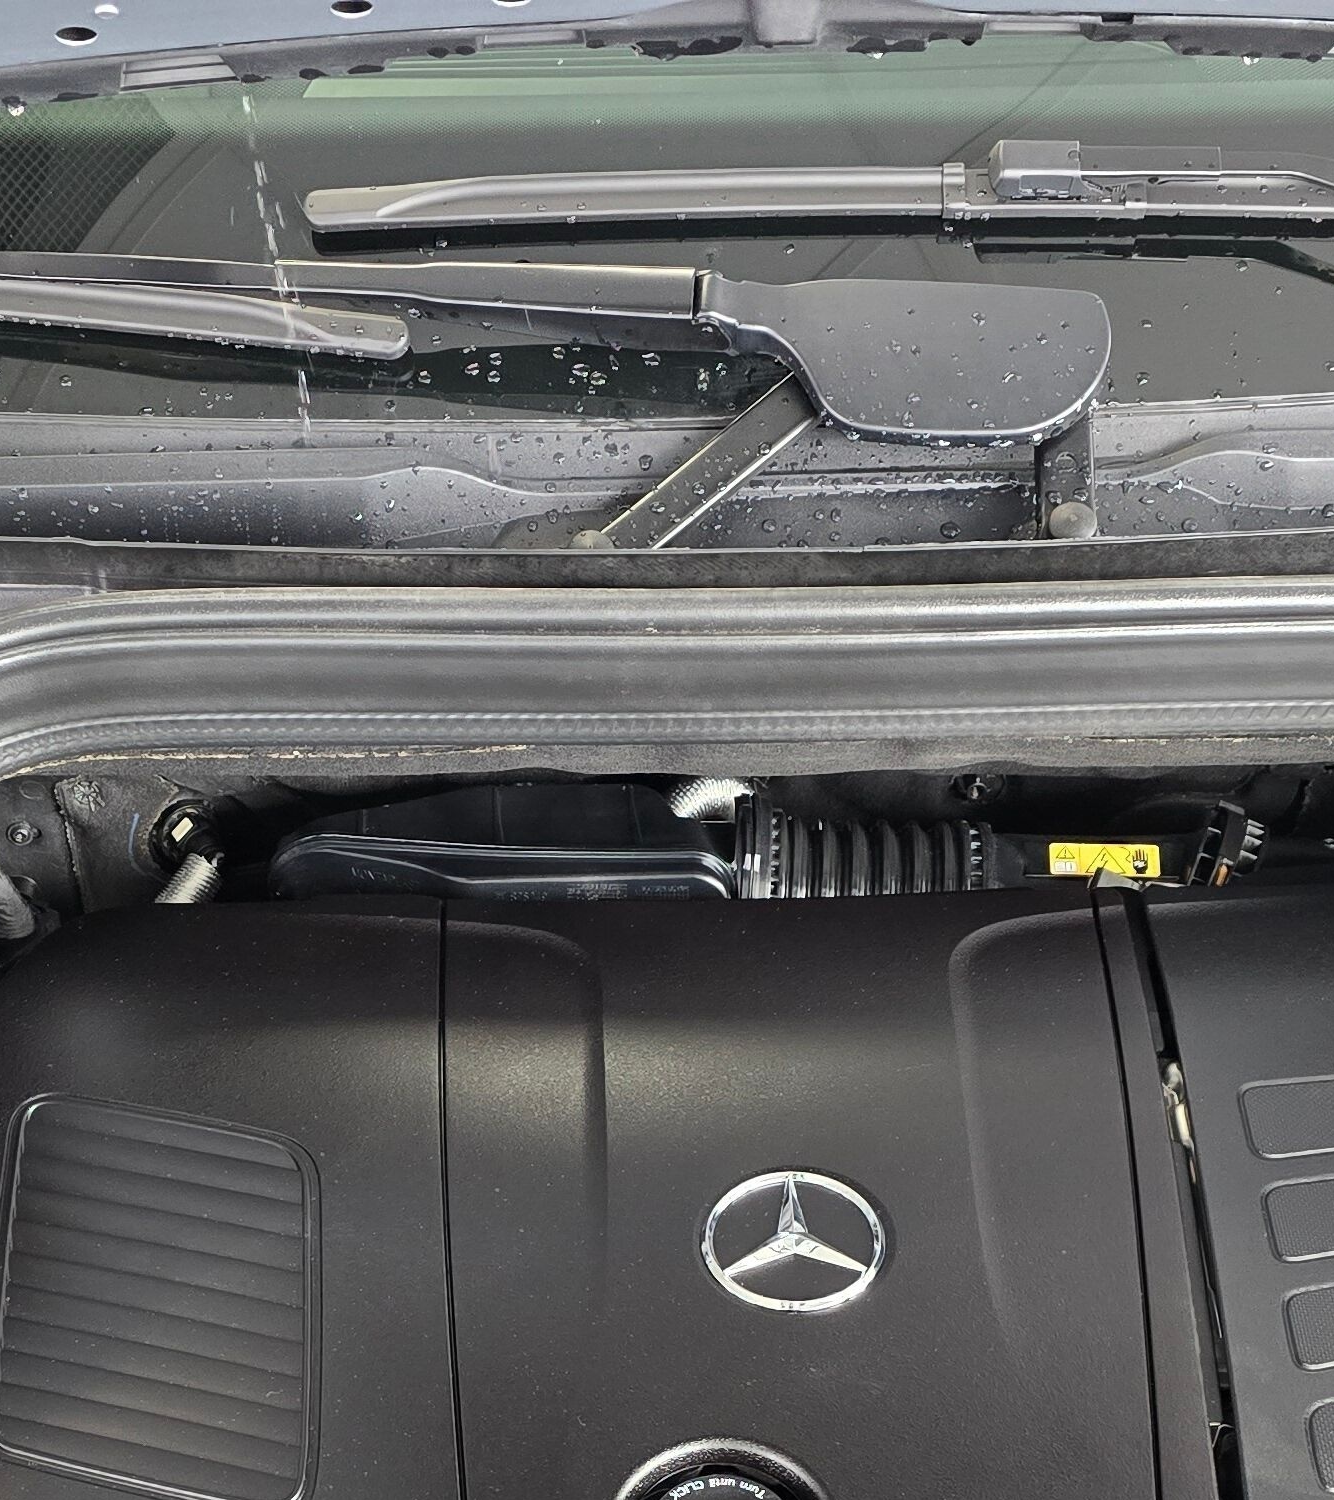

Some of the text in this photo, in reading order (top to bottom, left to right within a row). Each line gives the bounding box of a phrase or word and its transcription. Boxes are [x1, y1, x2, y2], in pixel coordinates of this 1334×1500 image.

[668, 1477, 767, 1500] Turn until CLICK
